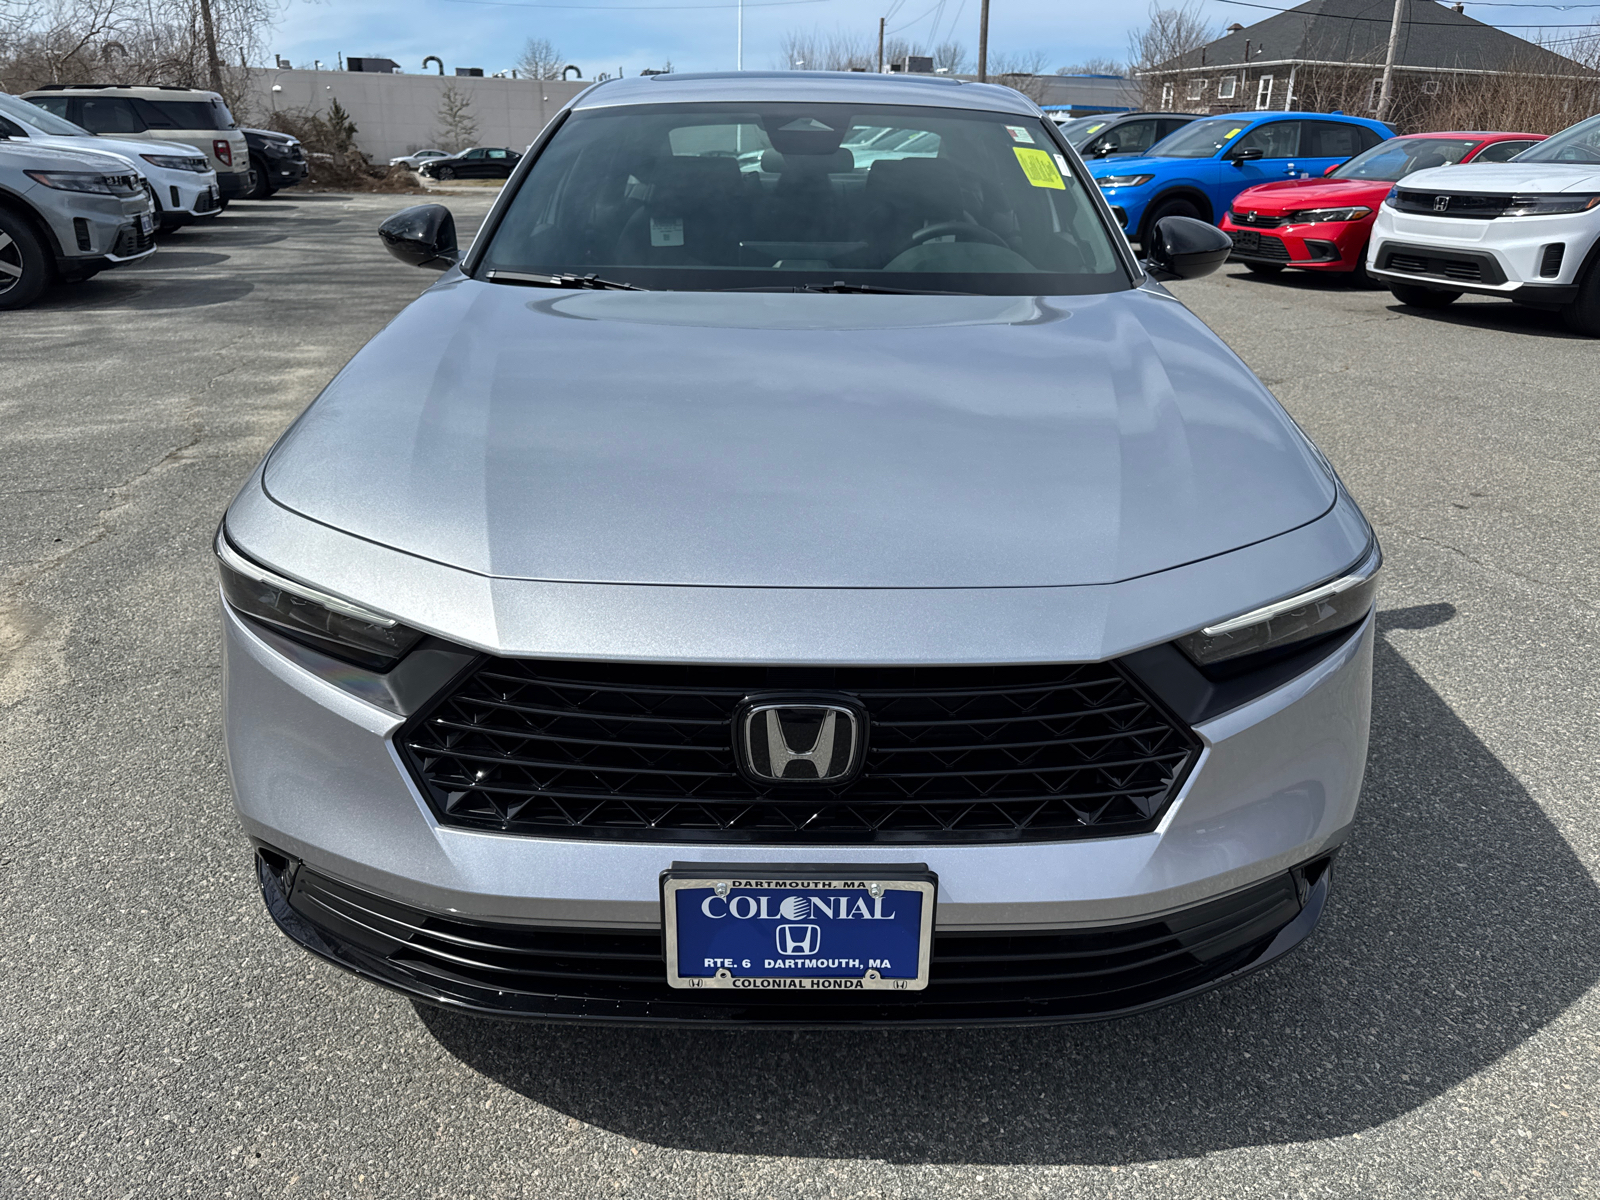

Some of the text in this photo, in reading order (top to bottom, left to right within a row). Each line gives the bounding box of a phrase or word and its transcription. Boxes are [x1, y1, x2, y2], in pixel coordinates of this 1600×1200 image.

[732, 880, 866, 889] DARTMOUTH, MA
[701, 895, 896, 921] COLONIAL
[704, 958, 892, 970] RTE. 6 DARTMOUTH, MA
[732, 979, 864, 989] COLONIAL HONDA
